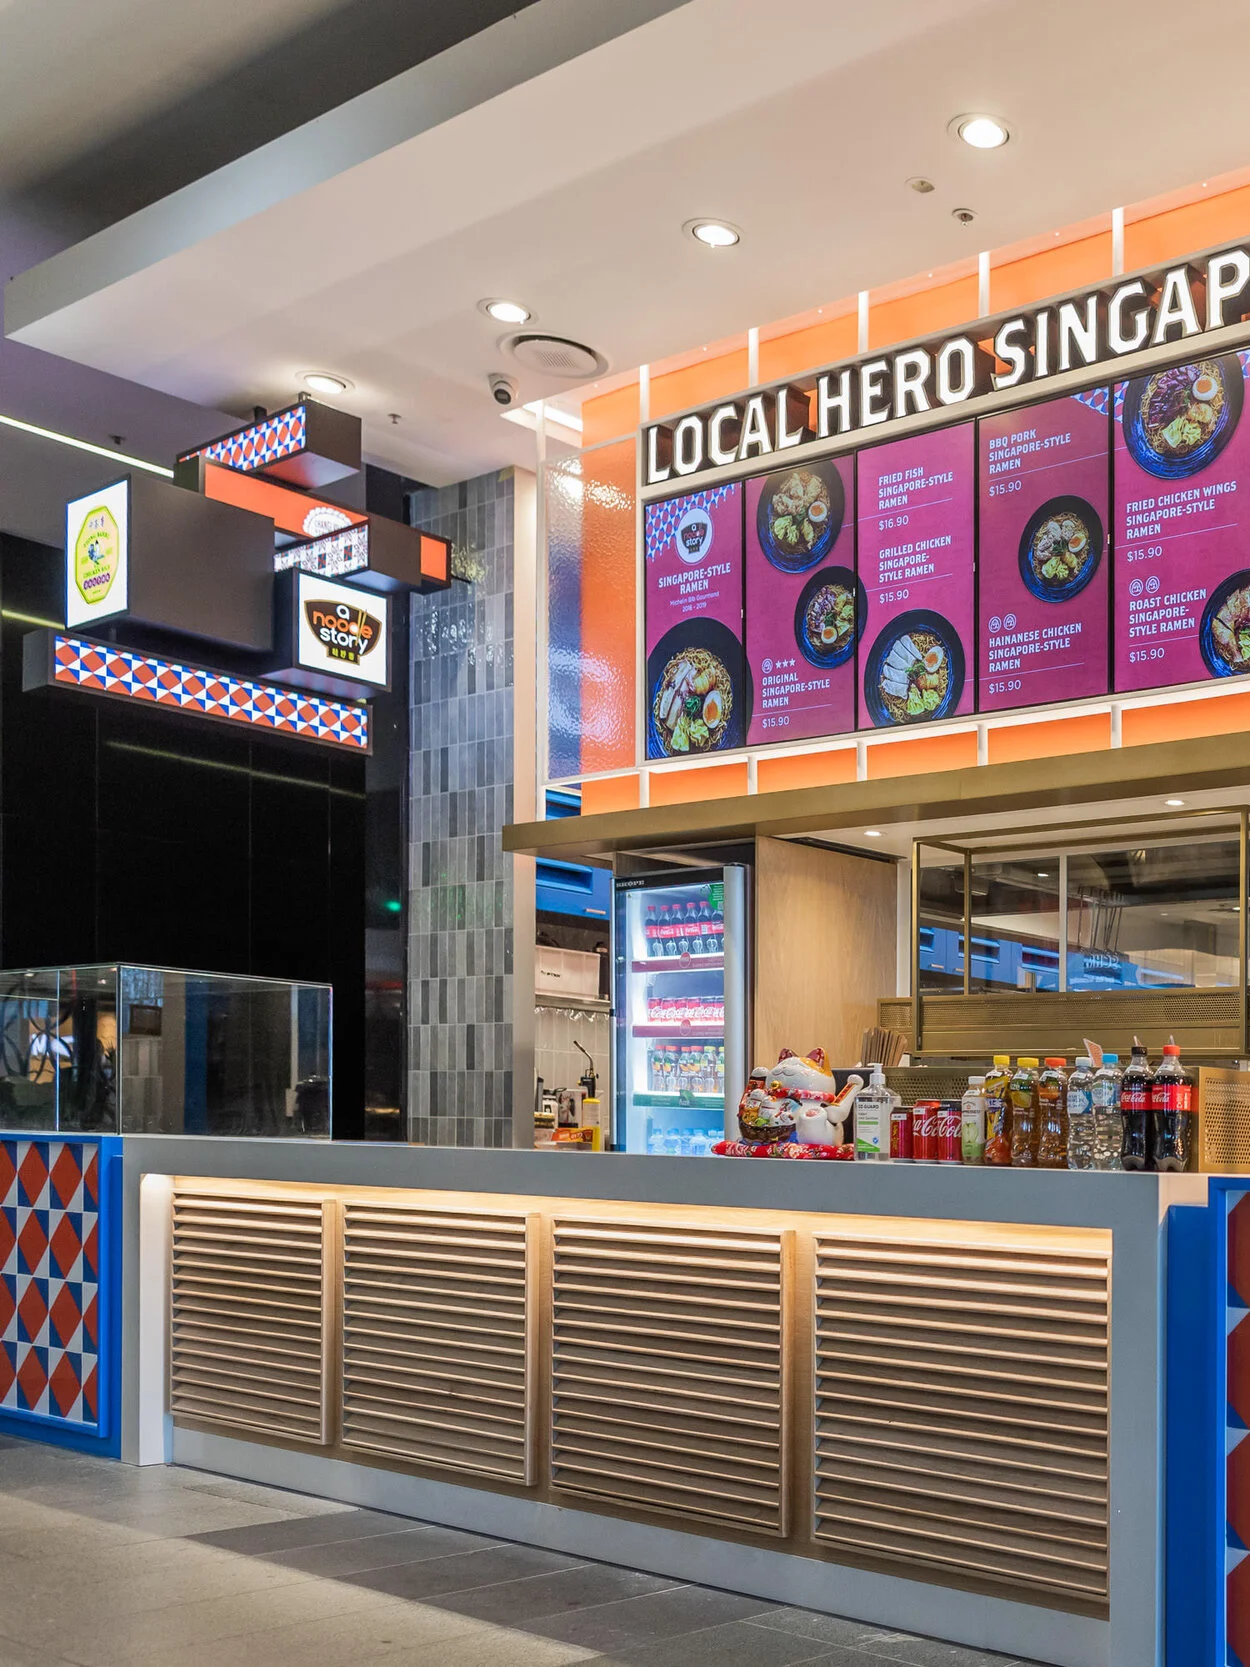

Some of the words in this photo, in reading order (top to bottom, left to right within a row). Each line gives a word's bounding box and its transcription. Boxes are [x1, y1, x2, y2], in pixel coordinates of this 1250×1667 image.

[647, 387, 803, 483] LOCAL
[818, 336, 976, 437] HERO
[989, 437, 1008, 450] BBQ
[1011, 429, 1036, 444] PORK
[989, 433, 1071, 462] SINGAPORE-STYLE
[989, 458, 1021, 474] RAMEN
[878, 472, 903, 486] FRIED
[905, 467, 924, 480] FISH
[878, 471, 953, 498] SINGAPORE-STYLE
[989, 480, 1022, 497] $15.90
[1126, 498, 1155, 513] FRIED
[1158, 488, 1200, 506] CHICKEN
[1203, 481, 1237, 497] WINGS
[878, 495, 908, 510] RAMEN
[1126, 499, 1215, 526] SINGAPORE-STYLE
[878, 515, 909, 531] $16.90
[1126, 523, 1161, 540] RAMEN
[686, 536, 703, 547] story
[879, 544, 913, 559] GRILLED
[915, 535, 952, 551] CHICKEN
[879, 555, 930, 571] SINGAPORE-
[1127, 546, 1163, 562] $15.90
[658, 562, 731, 588] SINGAPORE-STYLE
[879, 569, 903, 583] STYLE
[905, 563, 934, 578] RAMEN
[680, 579, 709, 595] RAMEN
[879, 589, 909, 604] $15.90
[1129, 596, 1161, 611] ROAST
[1164, 588, 1207, 605] CHICKEN
[336, 604, 350, 620] a
[1129, 606, 1189, 624] SINGAPORE-
[313, 610, 373, 639] noodle
[1129, 623, 1157, 638] STYLE
[1160, 618, 1195, 632] RAMEN
[320, 627, 369, 655] story
[989, 630, 1040, 648] HAINANESE
[1042, 623, 1081, 638] CHICKEN
[989, 638, 1070, 660] SINGAPORE-STYLE
[1129, 647, 1165, 663] $15.90
[989, 658, 1021, 673] RAMEN
[762, 672, 799, 686] ORIGINAL
[762, 678, 831, 698] SINGAPORE-STYLE
[989, 679, 1022, 694] $15.90
[762, 696, 789, 709] RAMEN
[762, 716, 790, 729] $15.90
